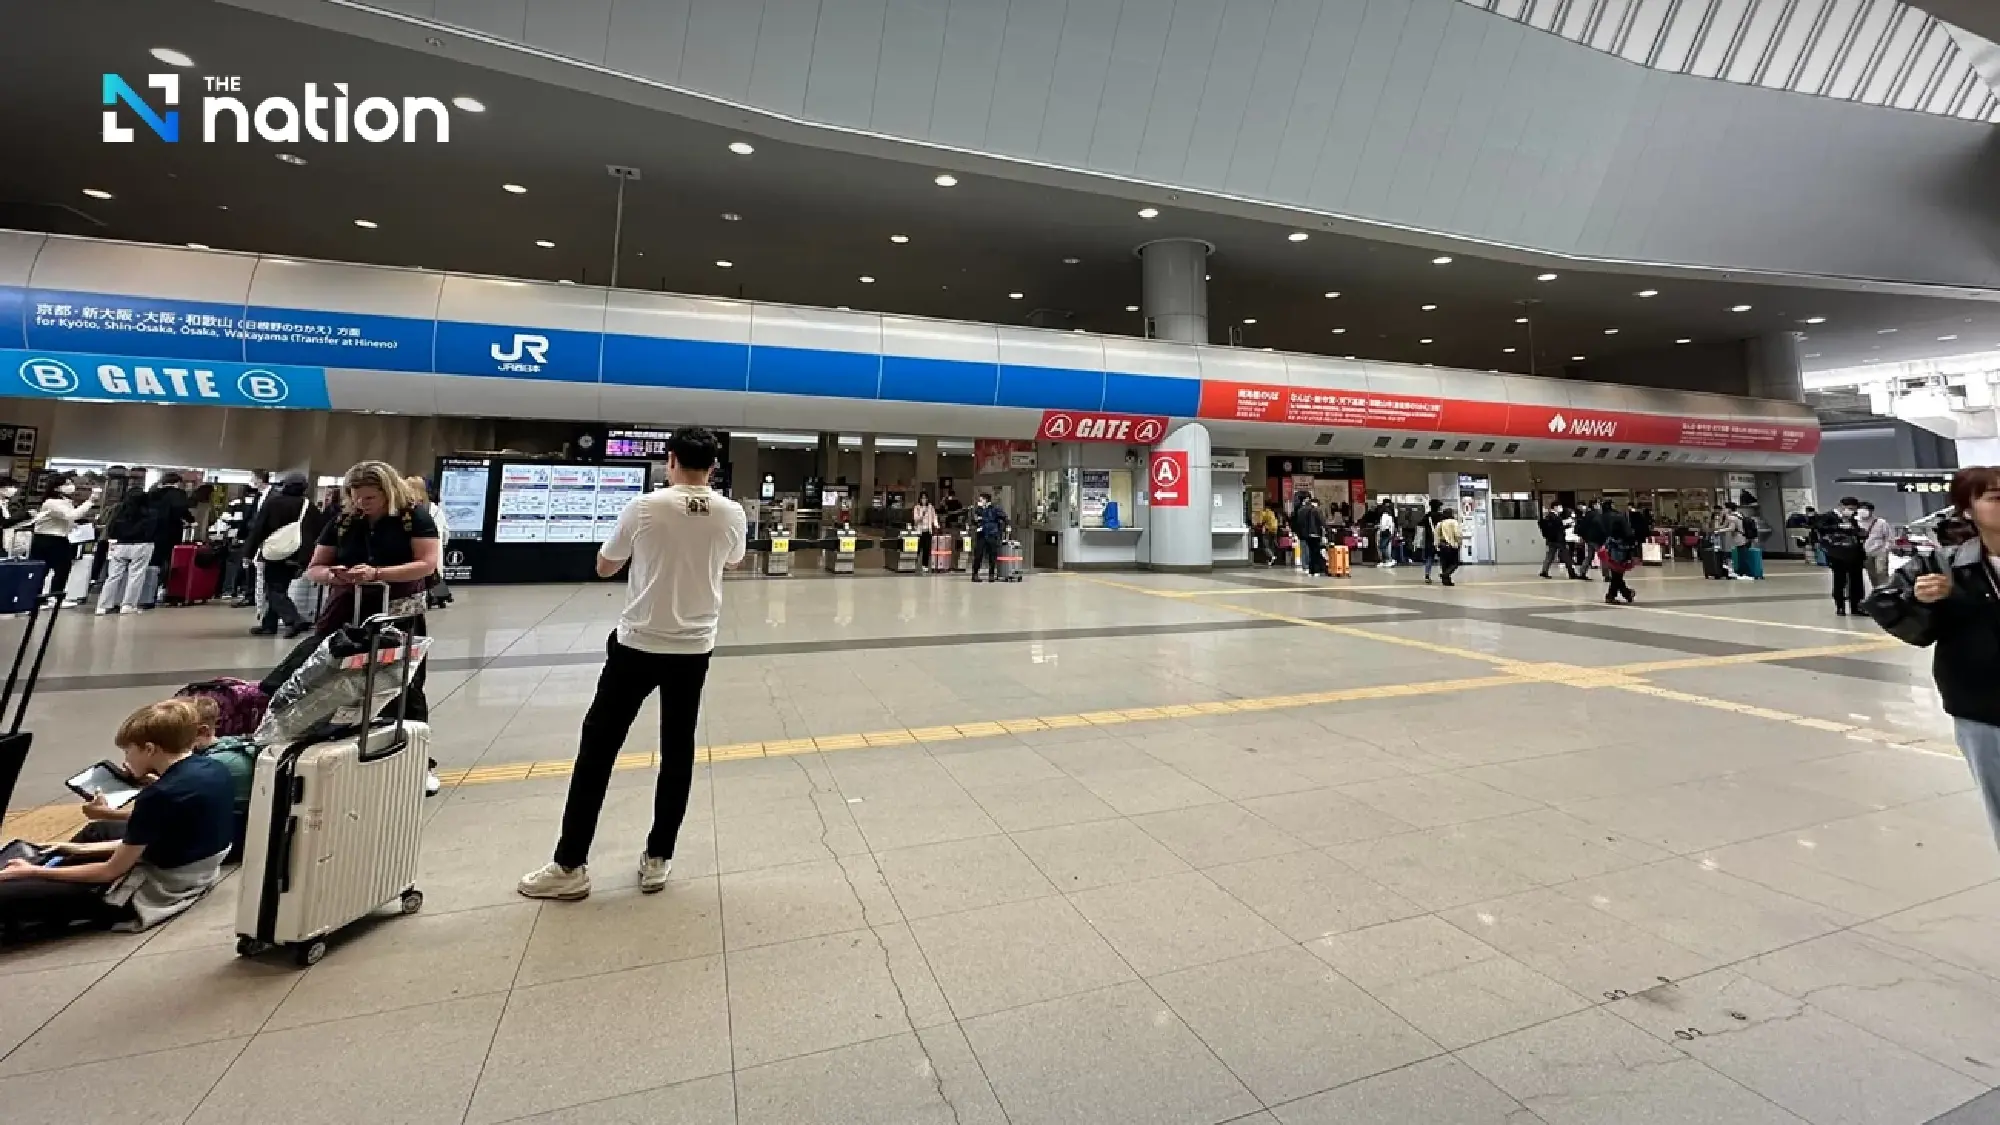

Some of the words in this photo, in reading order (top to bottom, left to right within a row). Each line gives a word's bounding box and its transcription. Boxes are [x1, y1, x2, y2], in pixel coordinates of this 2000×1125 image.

[36, 316, 56, 326] for
[225, 328, 289, 343] Wakayama
[291, 333, 339, 346] (Transfer
[342, 337, 353, 347] at
[354, 339, 398, 350] Hineno)
[491, 333, 549, 364] JR
[96, 364, 221, 398] GATE
[1075, 418, 1132, 440] GATE
[1568, 418, 1618, 437] NANKAI
